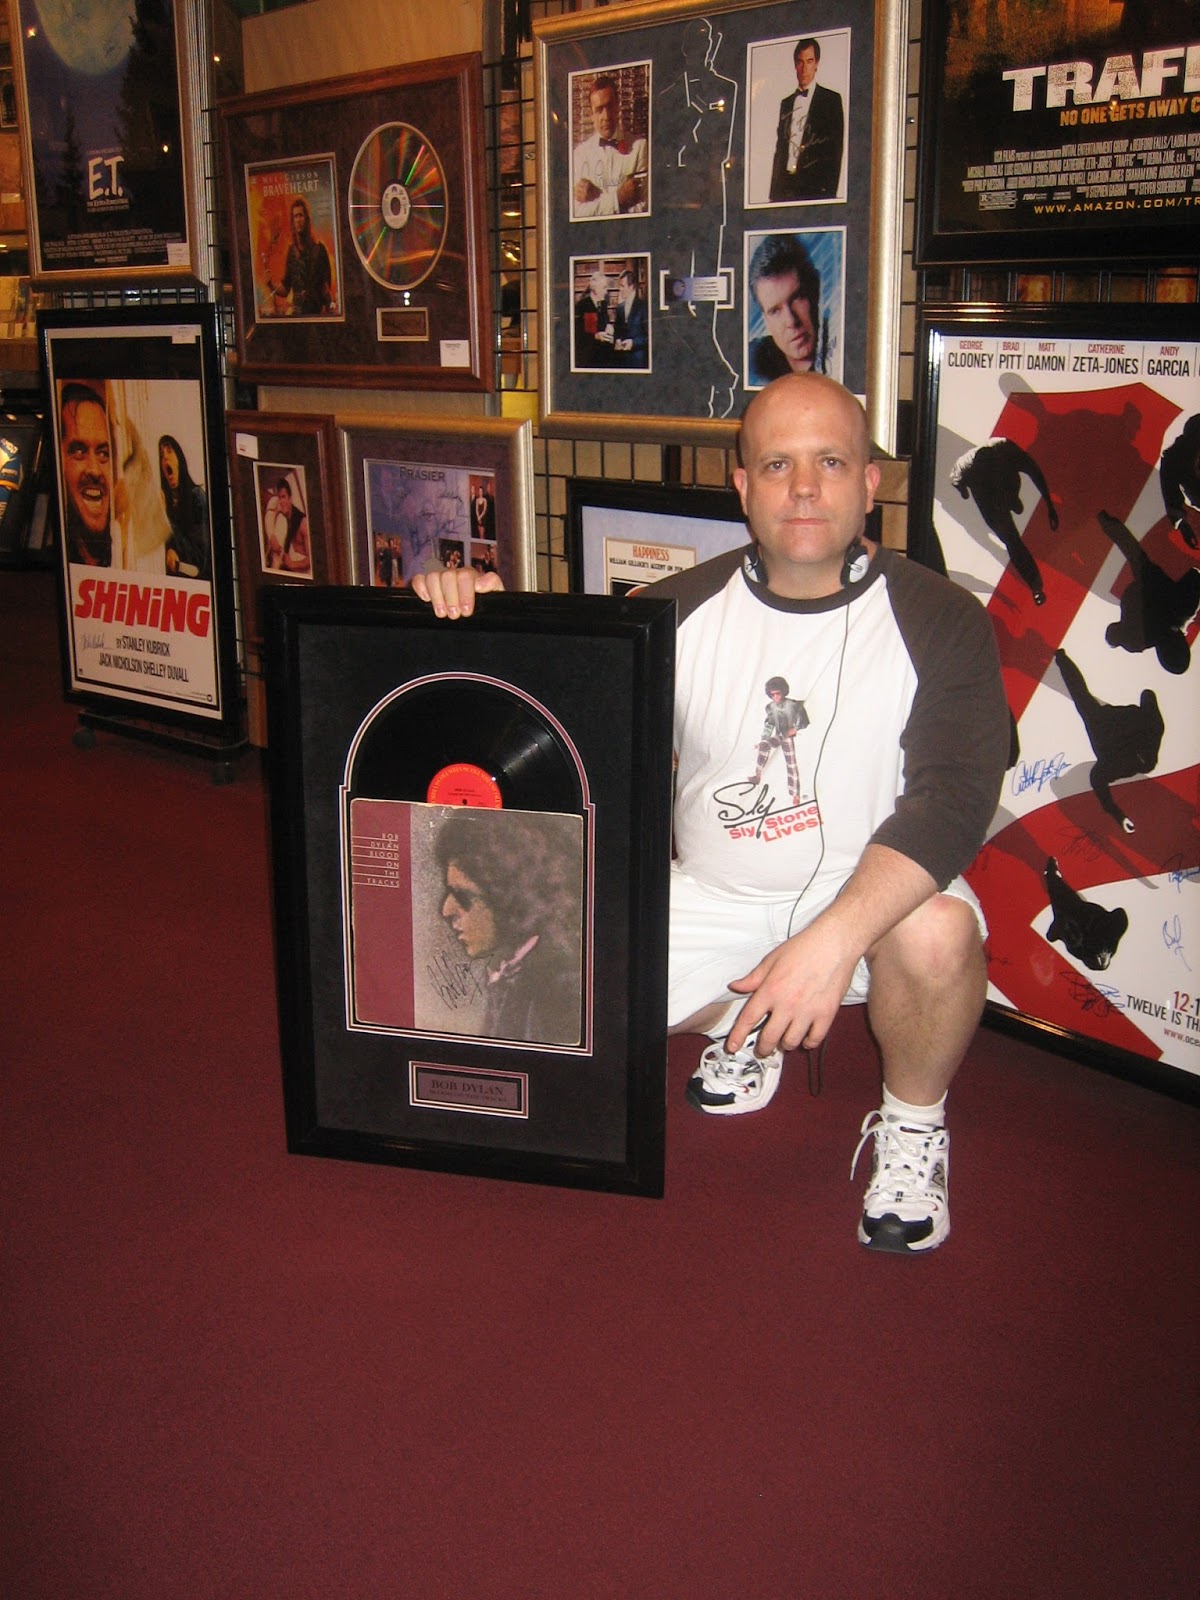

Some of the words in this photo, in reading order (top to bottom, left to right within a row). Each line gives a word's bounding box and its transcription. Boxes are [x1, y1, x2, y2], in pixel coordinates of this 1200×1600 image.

[1060, 109, 1078, 127] NO
[1081, 106, 1108, 125] ONE
[1109, 102, 1145, 123] GETS
[1147, 97, 1189, 119] AWAY
[88, 155, 125, 200] E.T.
[263, 180, 319, 197] BRAVEHEART
[959, 340, 983, 351] GEORGE
[1002, 341, 1020, 352] BRAD
[1038, 342, 1056, 352] MATT
[1088, 343, 1126, 355] CATHERINE
[1160, 345, 1180, 357] ANDY
[948, 352, 994, 369] CLOONEY
[999, 354, 1022, 370] PITT
[1027, 355, 1066, 372] DAMON
[1072, 356, 1139, 375] ZETA-JONES
[1147, 359, 1190, 377] GARCIA
[400, 466, 446, 481] FRASIER
[632, 545, 670, 562] HAPPINESS
[122, 635, 146, 653] STANLEY
[146, 640, 171, 657] KUBRICK
[99, 652, 112, 669] JACK
[112, 656, 143, 674] NICHOLSON
[142, 660, 166, 679] SHELLEY
[166, 664, 190, 683] DUVALL
[764, 805, 820, 829] Stone
[381, 832, 399, 841] BOB
[729, 825, 755, 840] Sly
[370, 841, 399, 850] DYLAN
[369, 850, 400, 860] BLOOD
[386, 861, 400, 869] ON
[384, 869, 400, 878] THE
[366, 877, 400, 888] TRACKS
[1126, 994, 1167, 1021] TWELVE
[1170, 1010, 1183, 1026] IS
[1185, 1014, 1200, 1033] TH
[1164, 1027, 1200, 1047] www.oce
[431, 1079, 458, 1091] BOB
[462, 1082, 504, 1096] DYLAN
